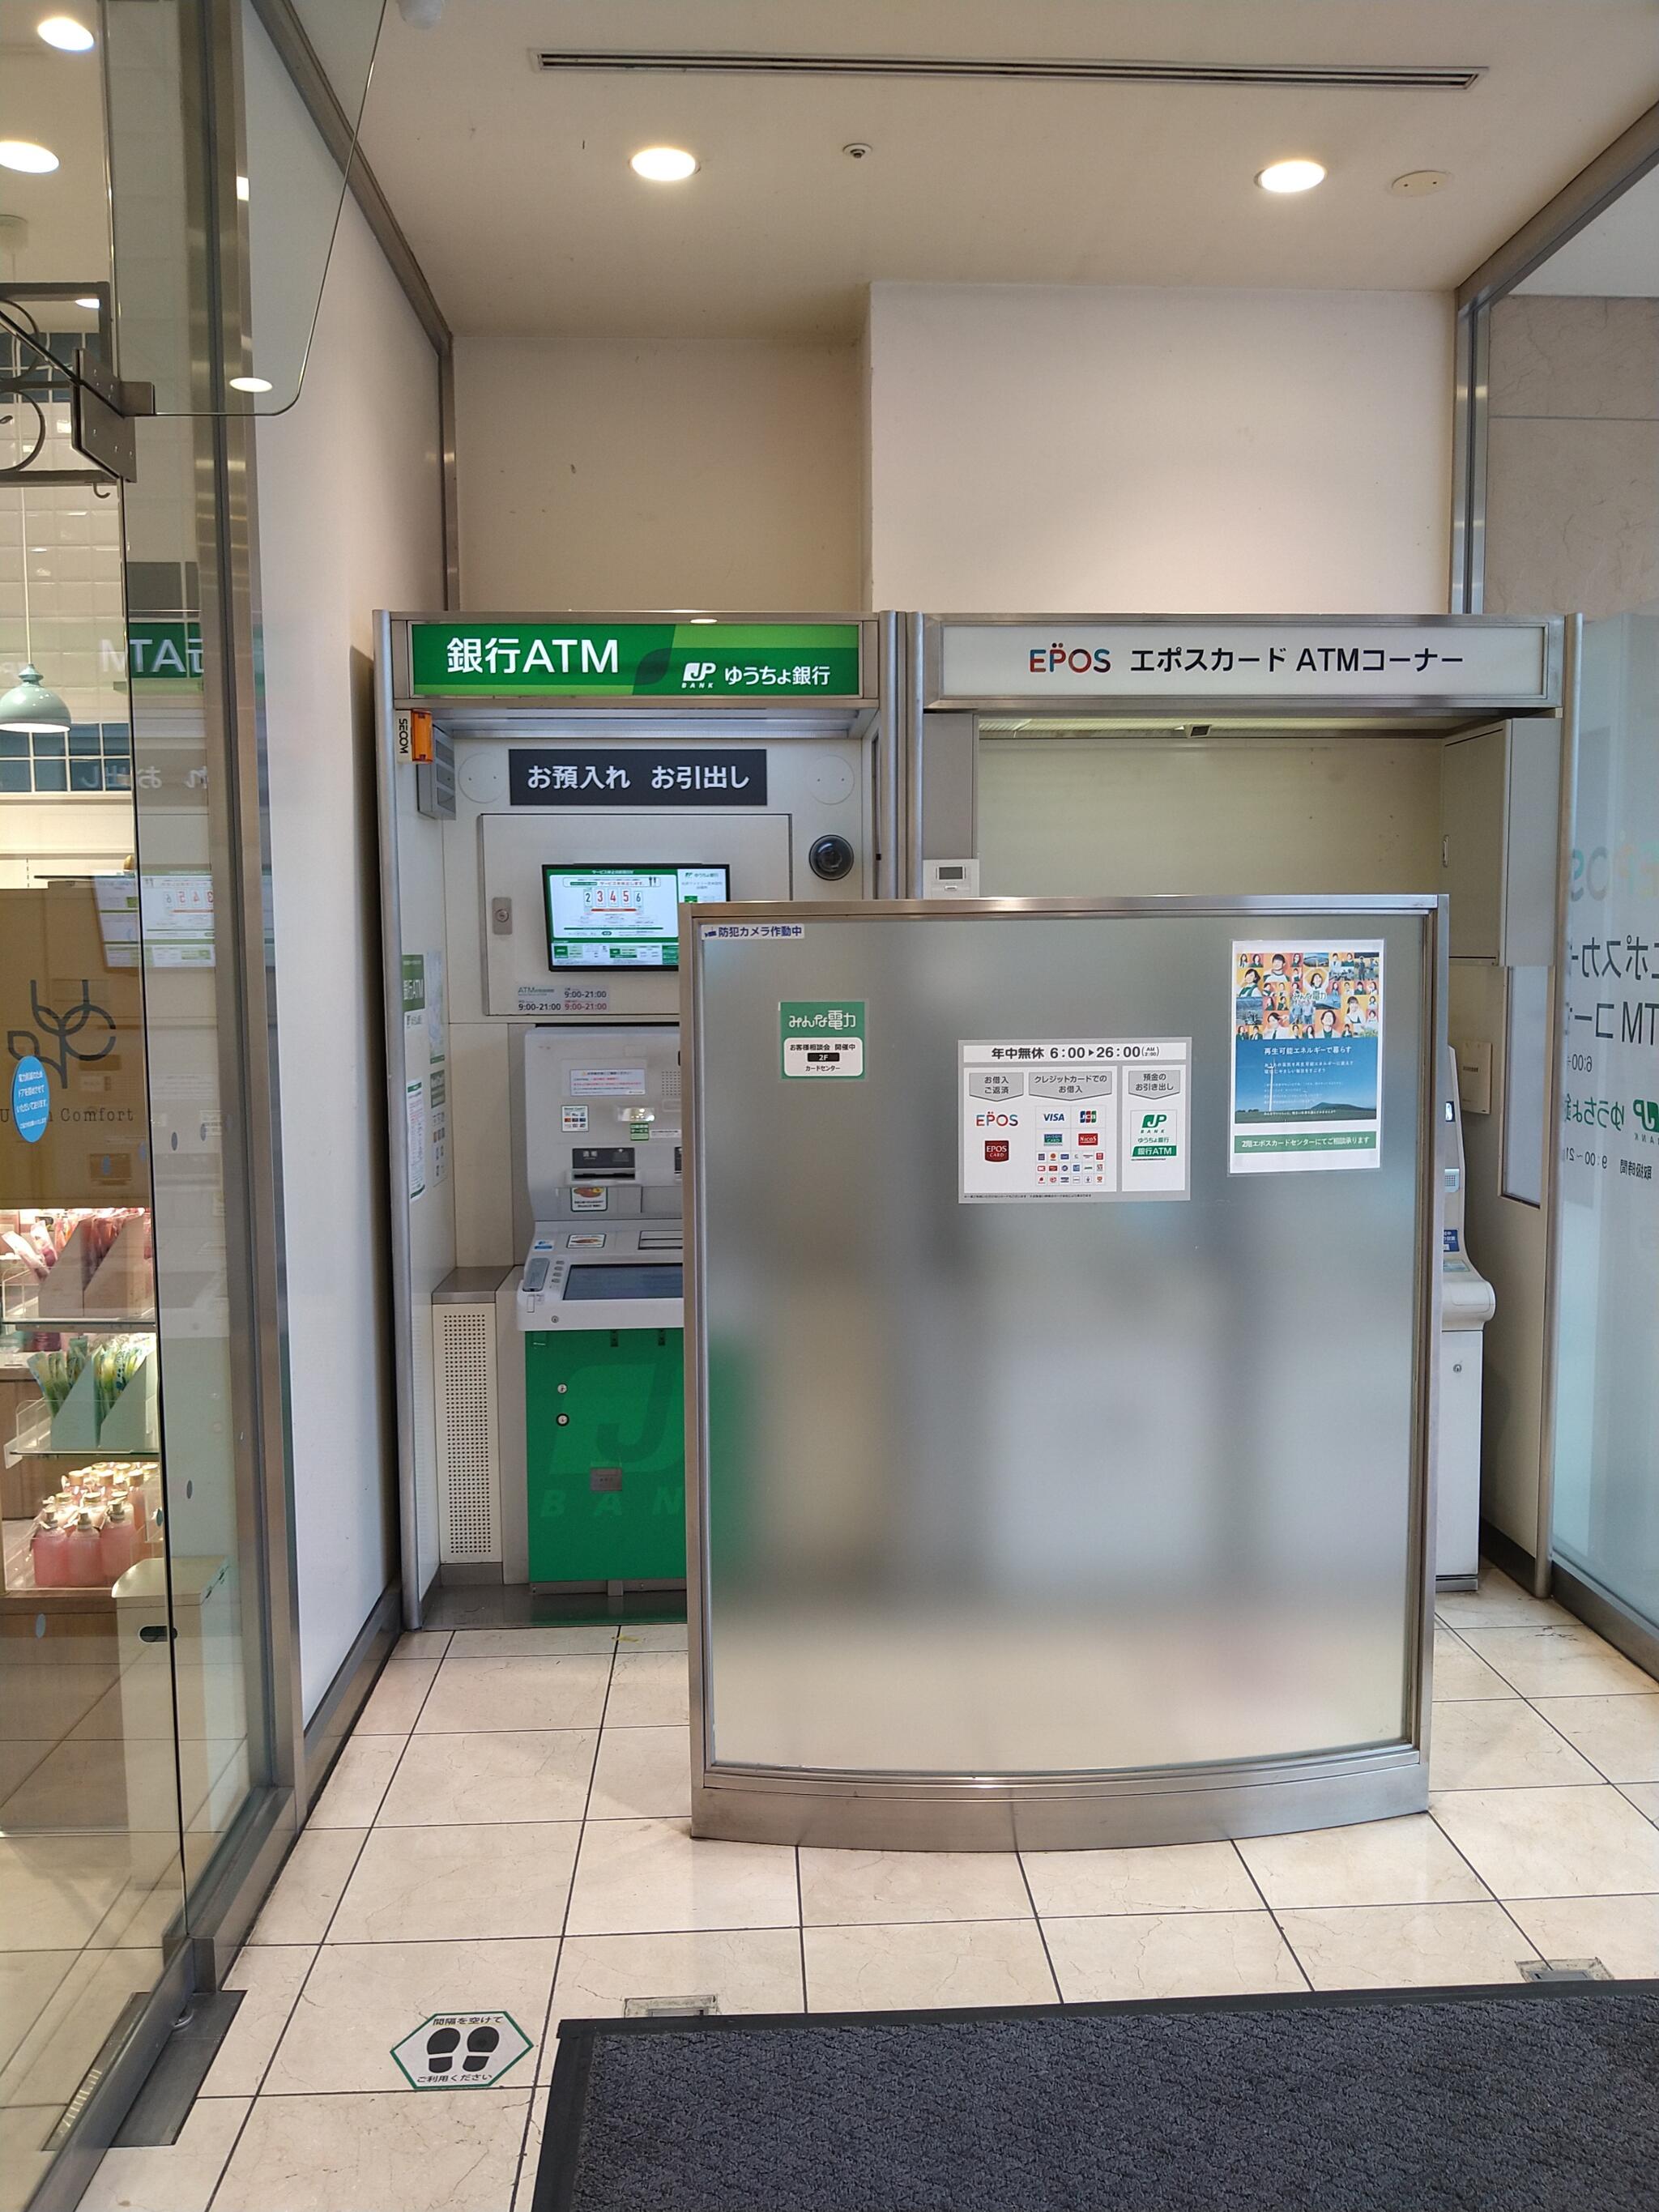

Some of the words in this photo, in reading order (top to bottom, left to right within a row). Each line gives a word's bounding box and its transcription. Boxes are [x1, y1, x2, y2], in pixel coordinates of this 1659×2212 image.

[447, 638, 618, 674] 銀行ATM
[1130, 647, 1285, 673] エポスカード
[1296, 647, 1463, 673] ATMコーナー
[683, 663, 716, 682] JP
[725, 666, 830, 685] ゆうちょ銀行
[399, 718, 409, 754] SECOM
[527, 765, 630, 790] お預入れ
[650, 765, 749, 790] お引出し
[585, 893, 591, 903] 2
[597, 890, 603, 902] 3
[610, 890, 616, 902] 4
[623, 890, 629, 902] 5
[636, 893, 641, 902] 6
[718, 926, 803, 938] 防犯カメラ作動中
[789, 1010, 856, 1030] みんな電力
[992, 1048, 1044, 1059] 年中無休
[1050, 1047, 1085, 1059] 6:00
[1096, 1046, 1141, 1058] 26:00
[1265, 1046, 1352, 1055] 再生可能エネルギーで暮らす
[984, 1076, 1009, 1084] お借入
[1034, 1075, 1107, 1084] クレジットカードでの
[1143, 1073, 1166, 1081] 預金の
[984, 1085, 1009, 1094] ご返済
[1058, 1085, 1083, 1093] お借入
[1135, 1083, 1174, 1091] お引き出し
[61, 1108, 134, 1122] Comfort
[976, 1111, 1018, 1127] EPOS
[1080, 1110, 1096, 1123] JCB
[1137, 1147, 1172, 1156] 銀行ATM
[433, 2015, 504, 2026] 間隔を空けて
[416, 2073, 493, 2083] ご利用ください
